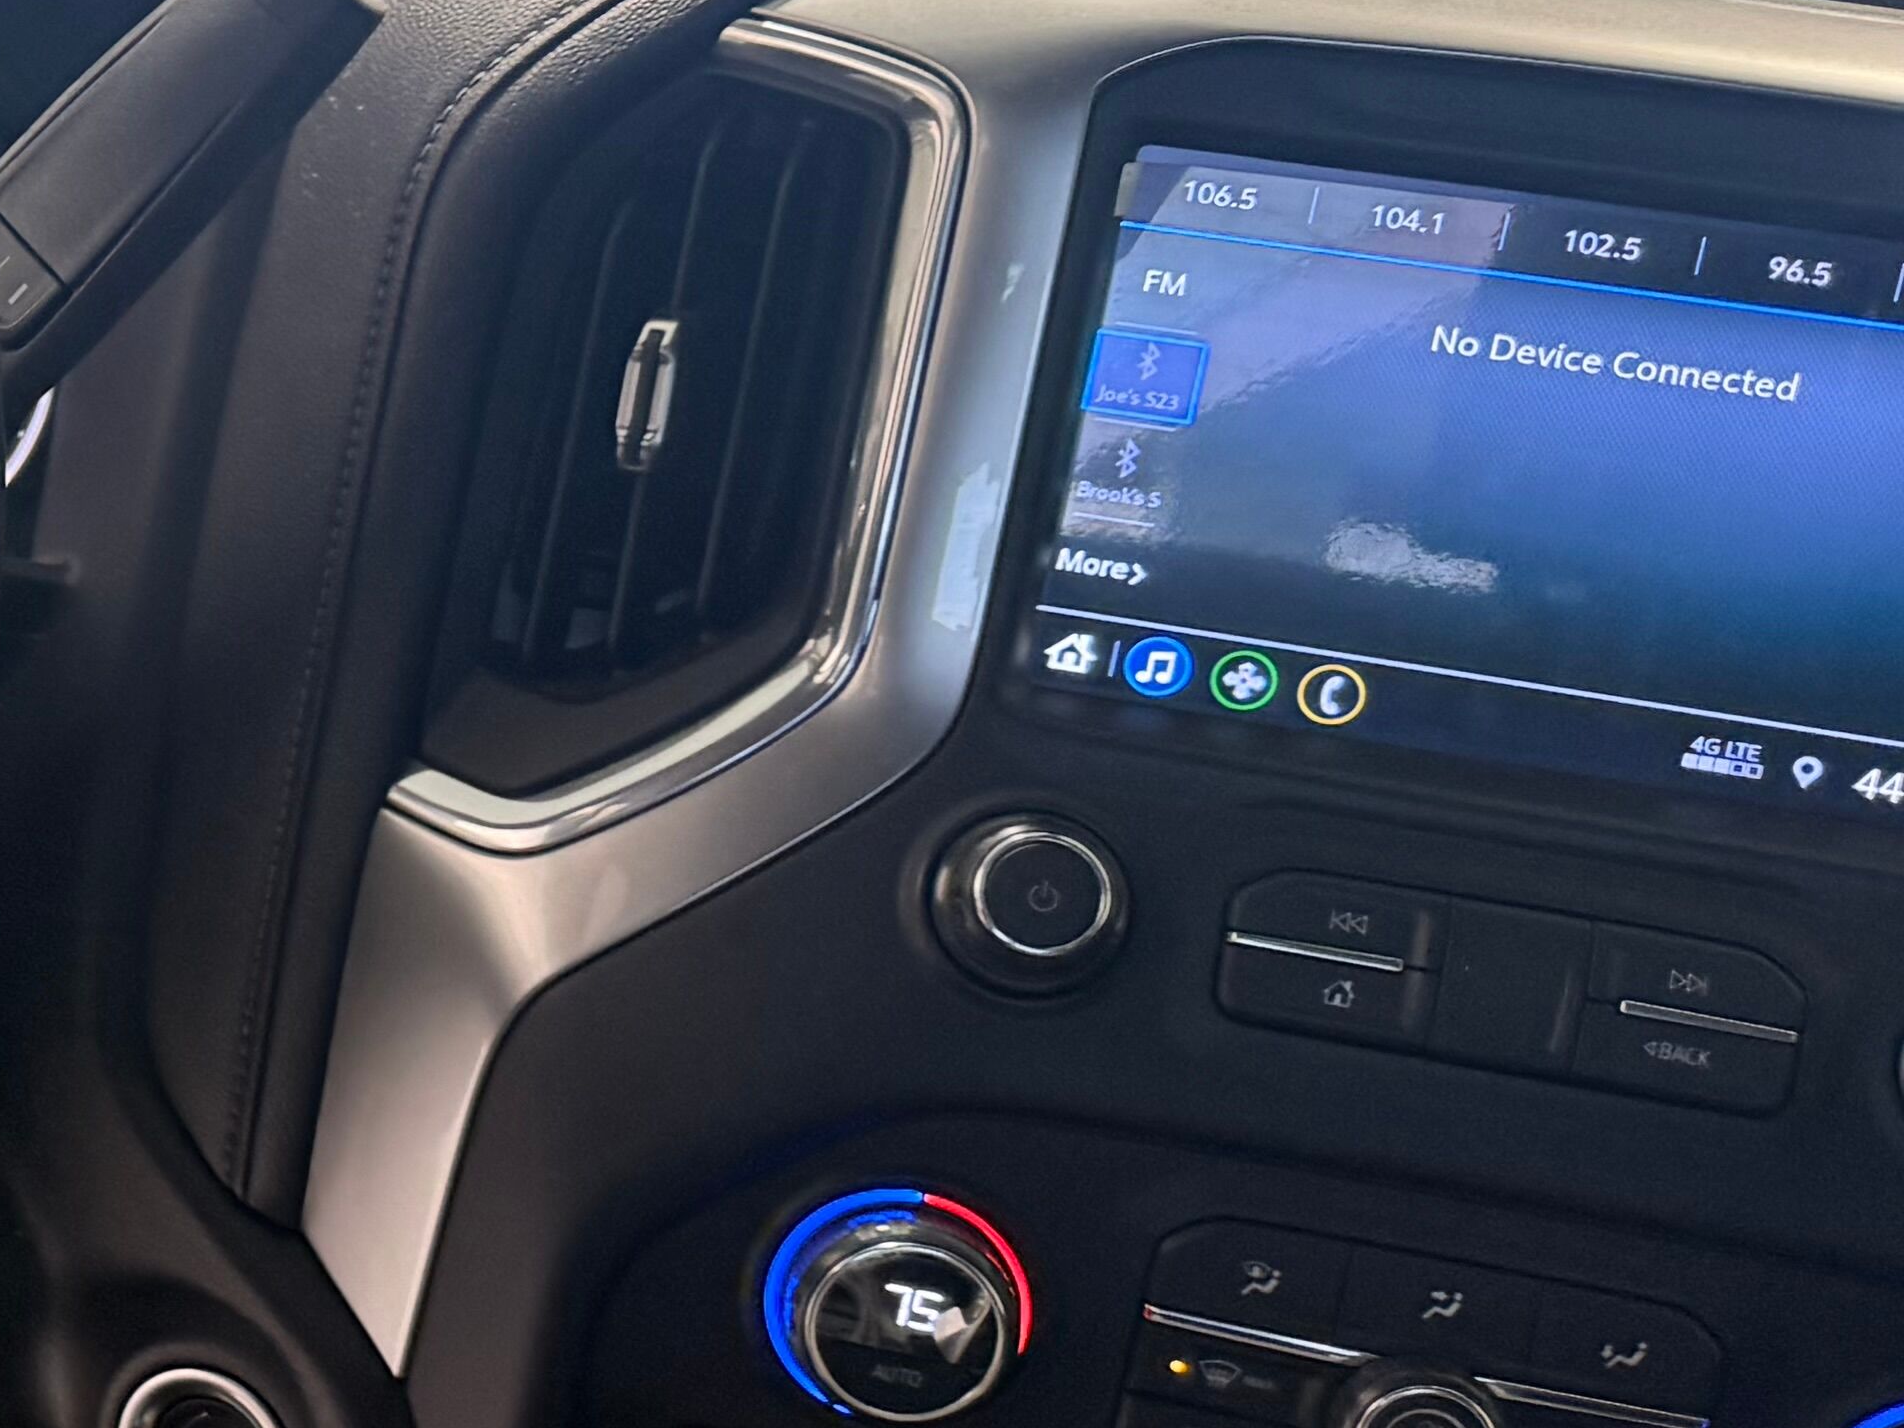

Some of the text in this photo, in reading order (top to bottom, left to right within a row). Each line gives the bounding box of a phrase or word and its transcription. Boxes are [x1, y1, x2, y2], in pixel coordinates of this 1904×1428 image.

[1183, 179, 1833, 288] 106.5 104.1 102.5 96.5
[1142, 269, 1187, 297] FM
[1430, 325, 1803, 402] No Device Connected
[1094, 384, 1180, 411] Joe's S23
[1689, 735, 1763, 762] 4G LTE
[1657, 1041, 1711, 1067] BACK
[884, 1282, 945, 1332] 75
